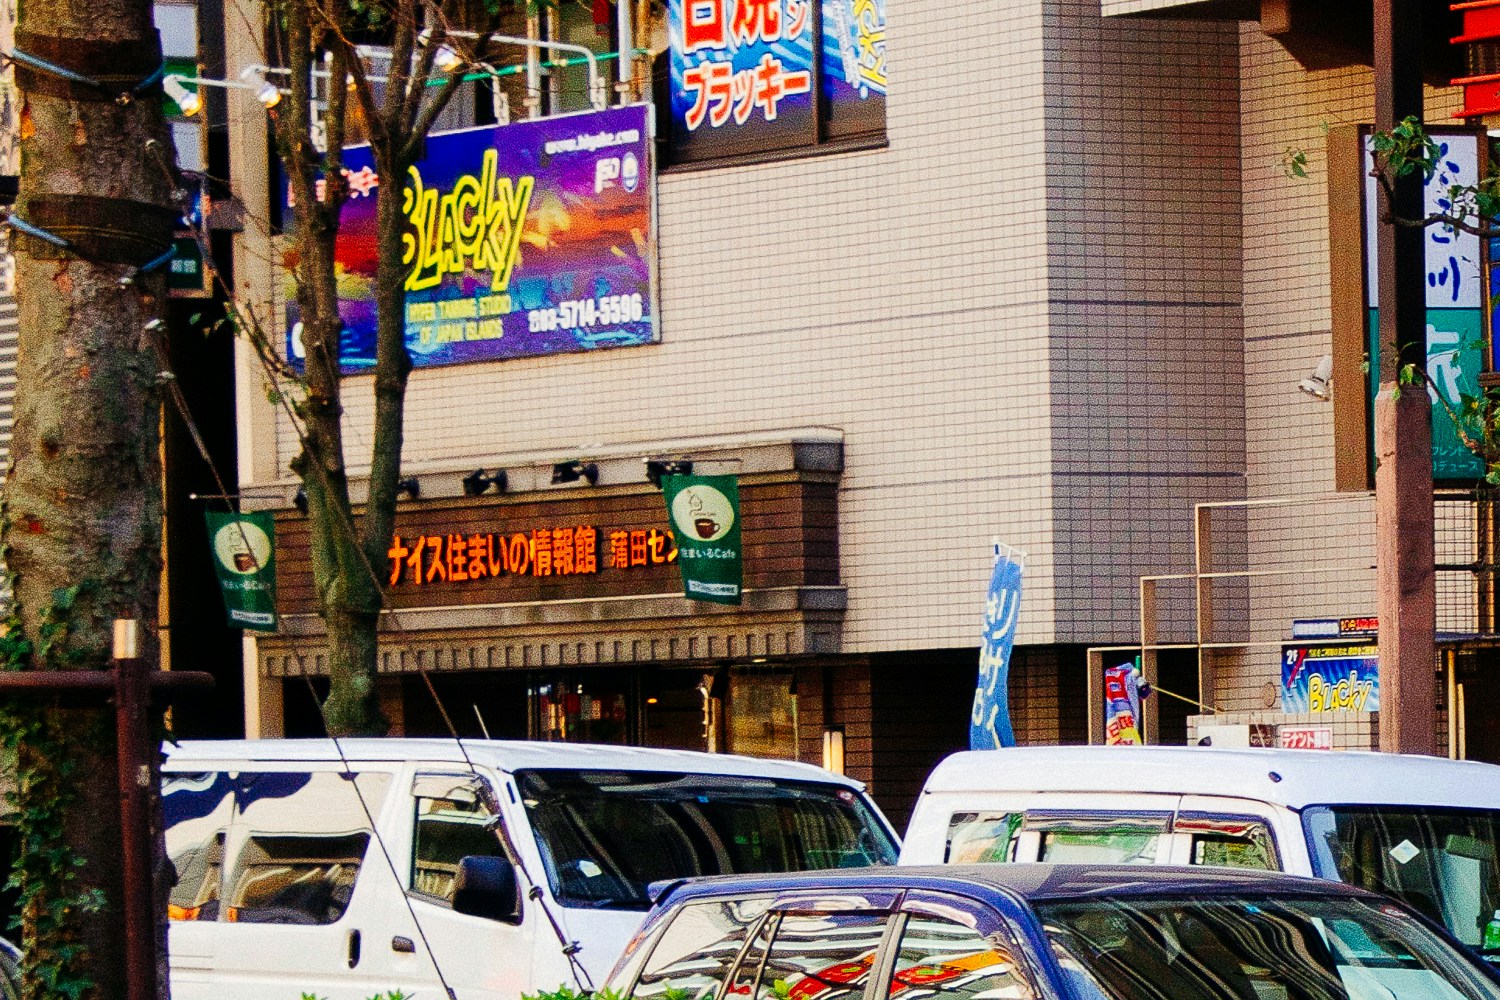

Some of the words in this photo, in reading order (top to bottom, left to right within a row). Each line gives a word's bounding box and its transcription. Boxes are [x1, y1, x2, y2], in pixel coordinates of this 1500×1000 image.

[684, 53, 811, 131] ブラッキー
[388, 525, 597, 586] ナイス住まいの情報館
